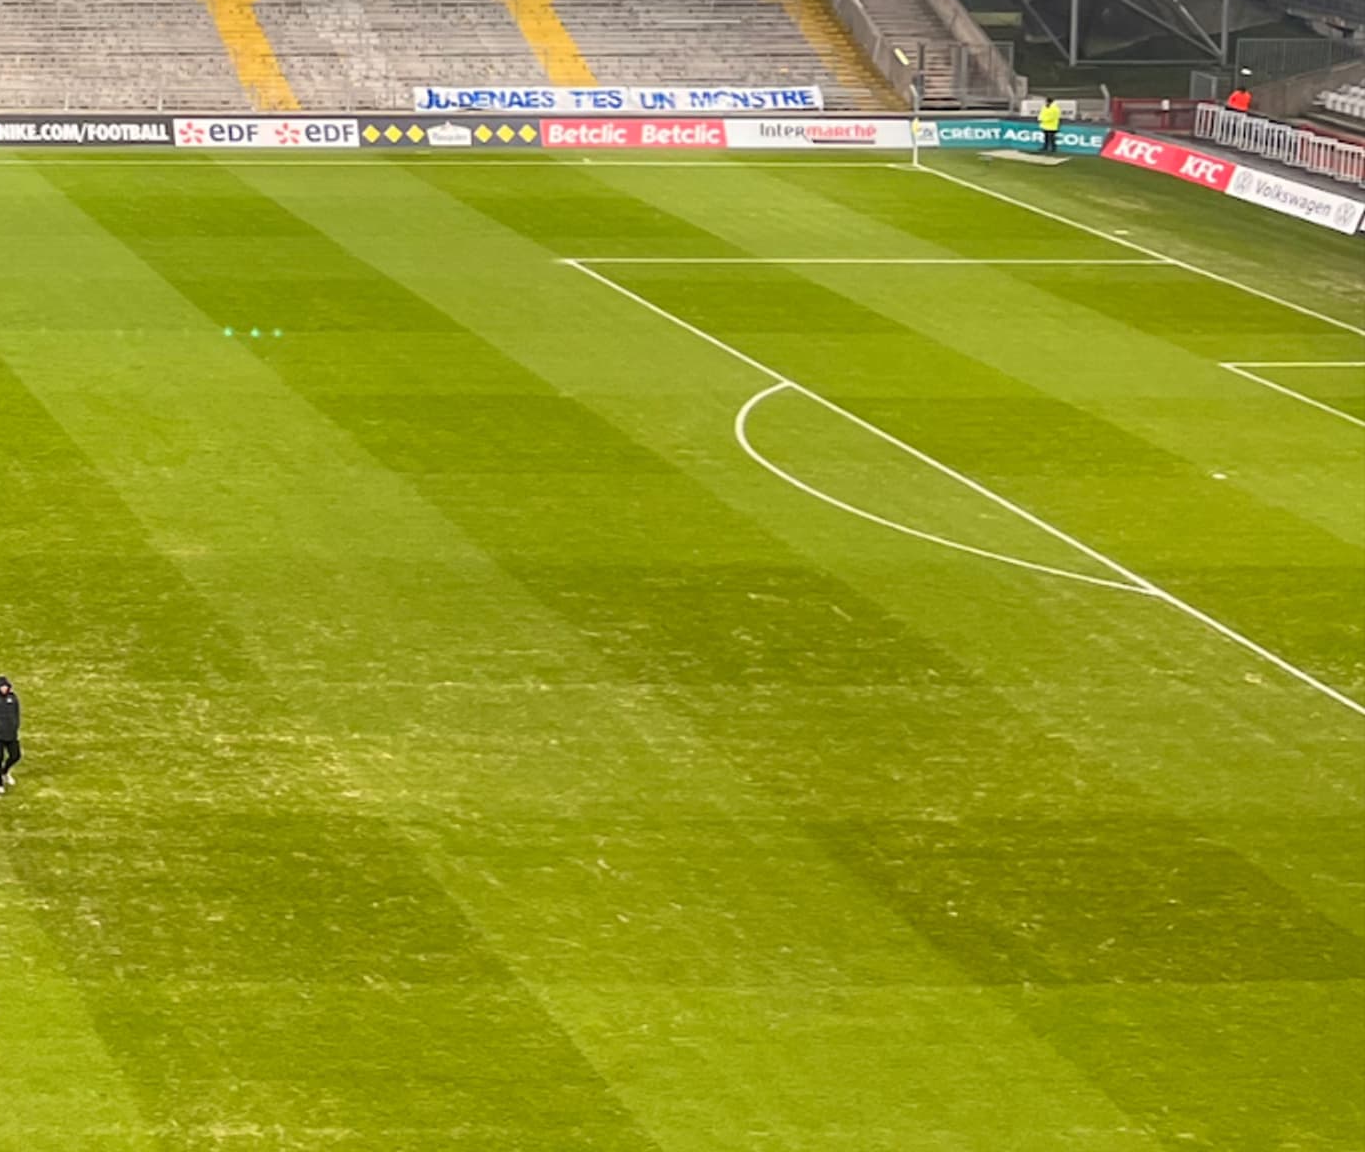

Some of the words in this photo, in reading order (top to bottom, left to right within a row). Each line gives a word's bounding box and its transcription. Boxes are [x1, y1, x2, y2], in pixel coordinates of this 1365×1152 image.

[640, 90, 676, 110] UN
[548, 125, 627, 145] Betclic
[640, 124, 721, 145] Betclic
[939, 125, 1000, 142] CRÉDIT
[1002, 129, 1104, 147] AGRCOLE
[1114, 132, 1163, 164] KFC
[1179, 154, 1224, 184] KFC
[1255, 178, 1332, 215] Volkswagen
